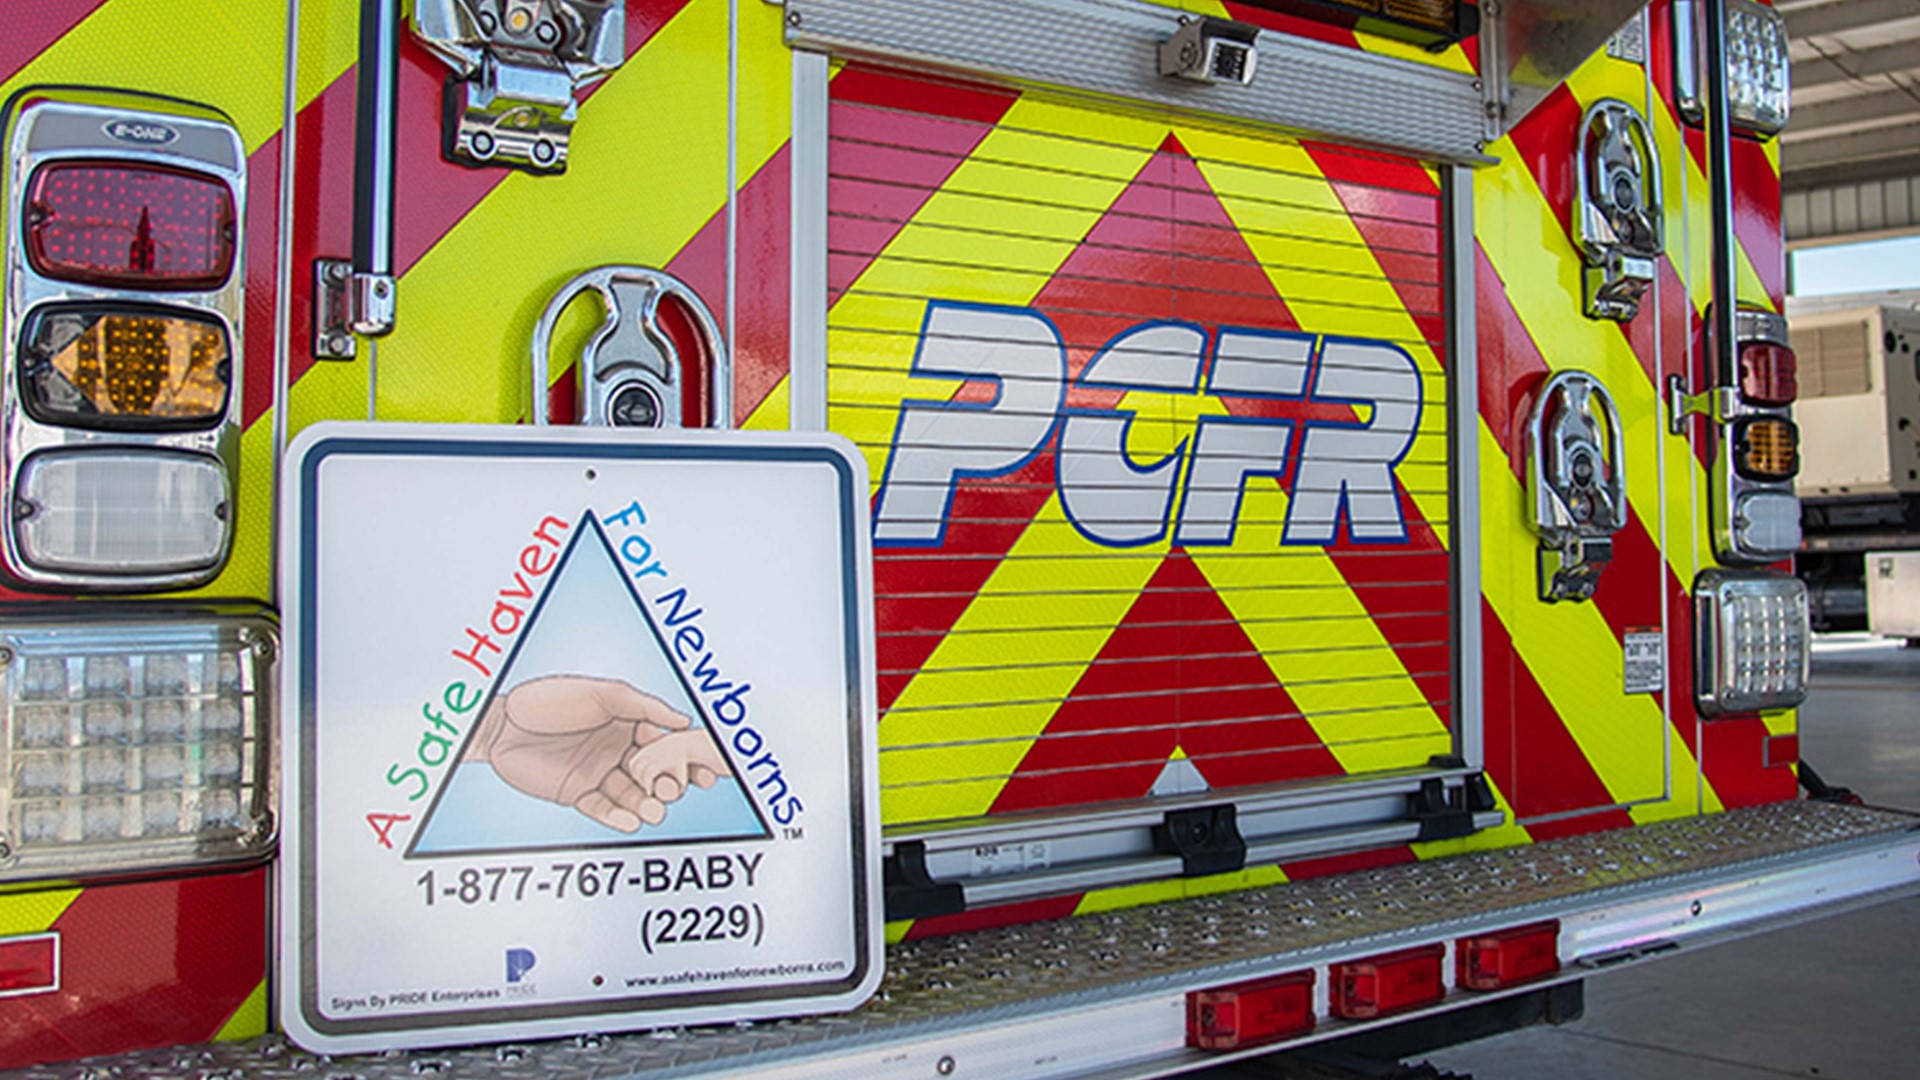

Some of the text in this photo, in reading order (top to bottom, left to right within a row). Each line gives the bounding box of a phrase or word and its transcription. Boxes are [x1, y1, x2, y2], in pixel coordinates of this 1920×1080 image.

[871, 298, 1423, 548] PCFR
[366, 515, 569, 849] A Safe Haven
[603, 500, 803, 825] For Newborns
[417, 852, 764, 905] 1-877-767-BABY
[641, 902, 764, 954] (2229)
